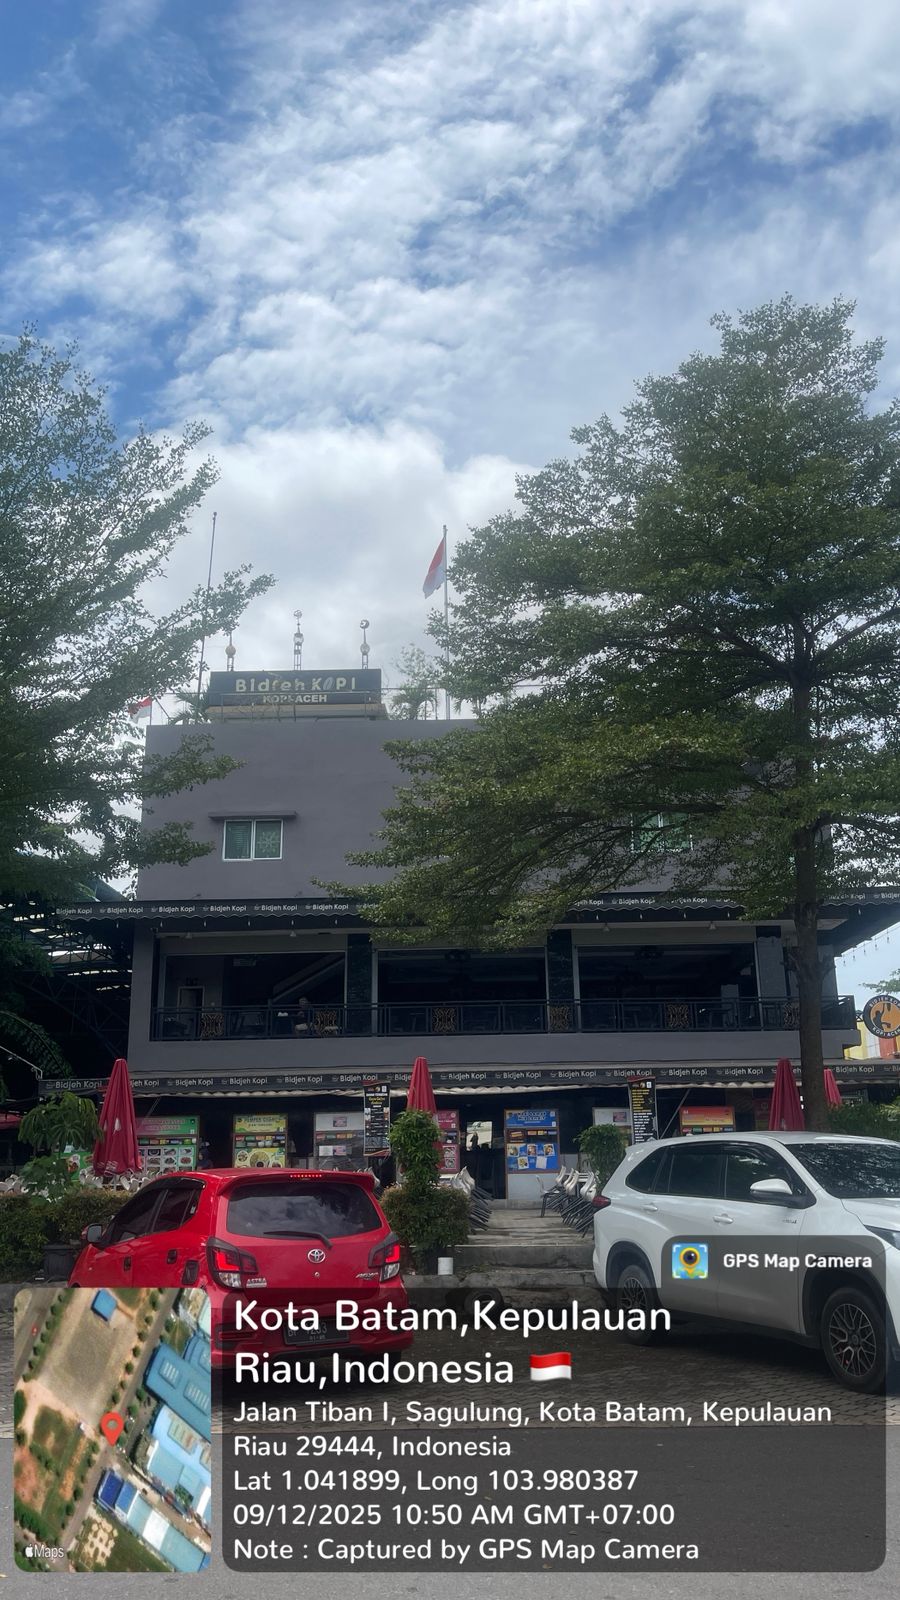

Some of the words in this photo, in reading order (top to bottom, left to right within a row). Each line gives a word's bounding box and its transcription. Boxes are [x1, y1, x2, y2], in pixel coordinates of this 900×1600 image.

[295, 694, 328, 703] ACEH
[558, 1070, 580, 1078] Bidjeh
[175, 1079, 197, 1087] Bidjeh
[198, 1078, 214, 1086] Kopi
[229, 1078, 251, 1086] Bidjeh
[340, 1075, 362, 1083] Bidjeh
[55, 1081, 82, 1089] Bidjeh
[83, 1080, 102, 1088] Kopi
[144, 1080, 160, 1088] Kopi
